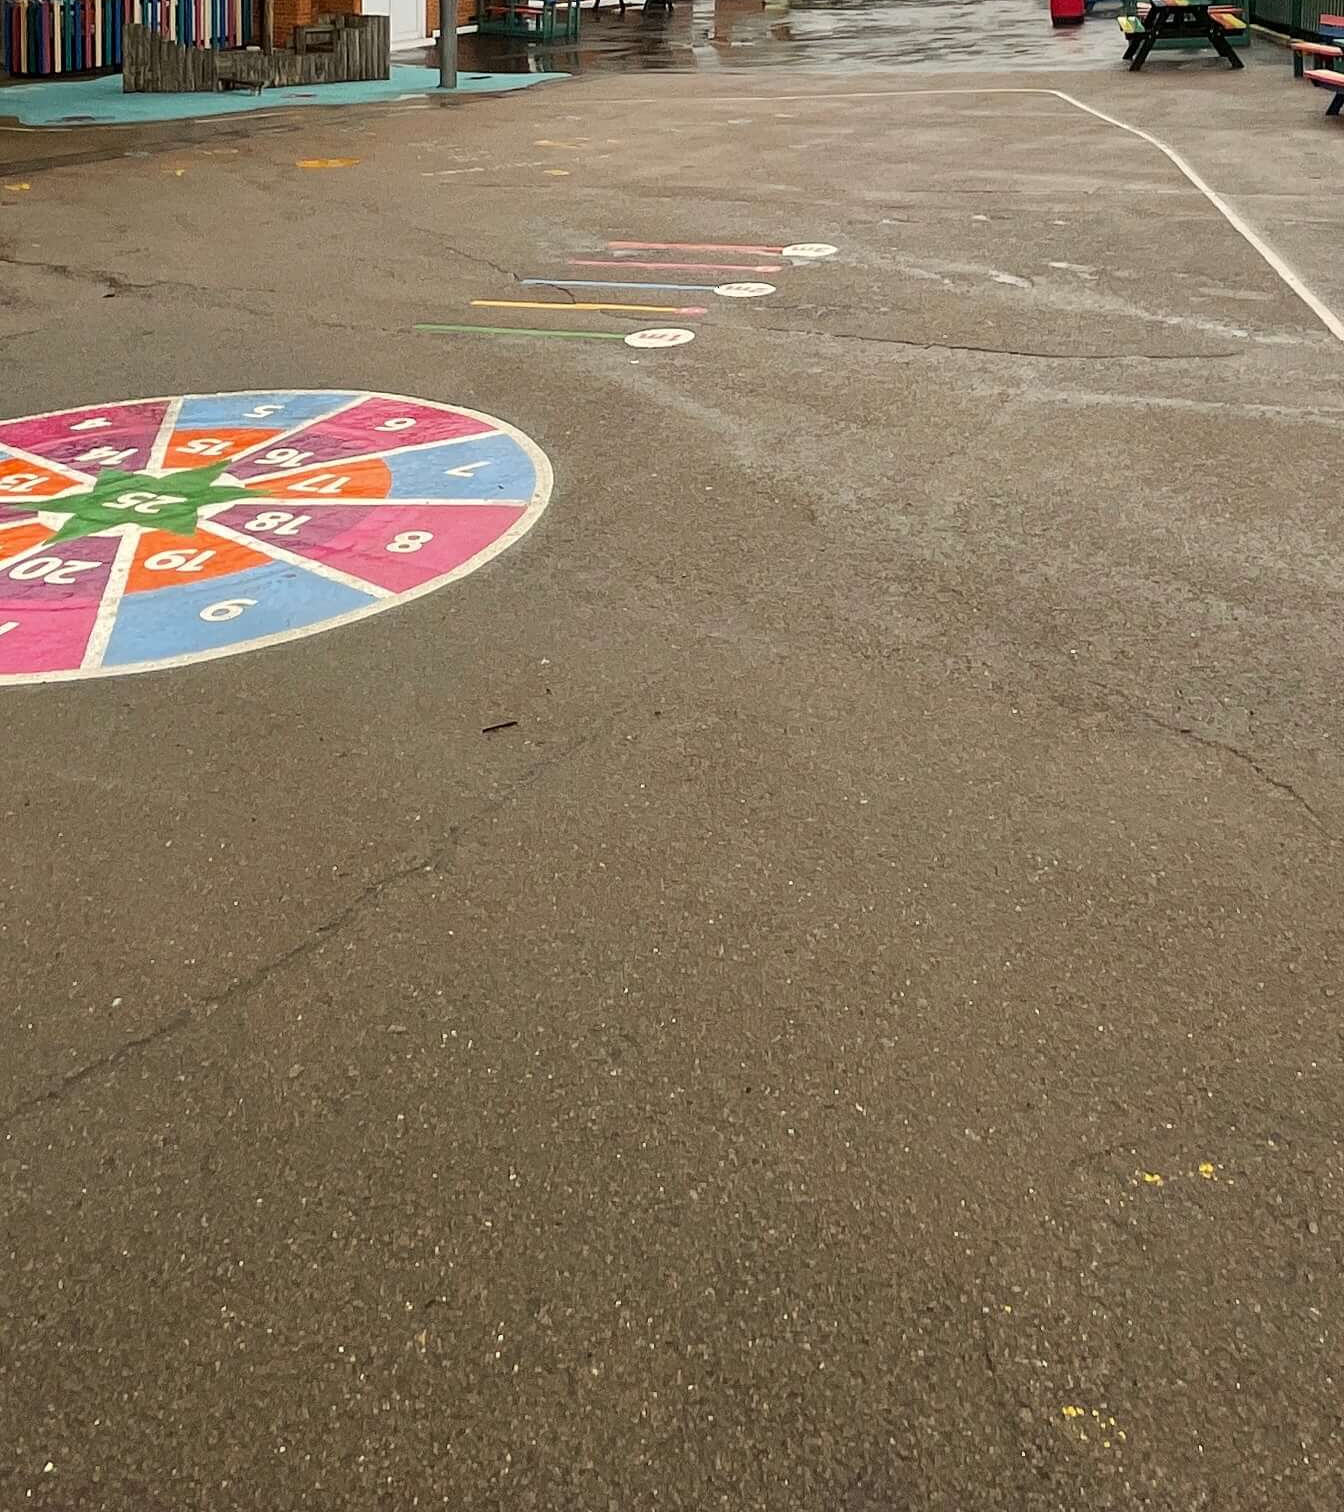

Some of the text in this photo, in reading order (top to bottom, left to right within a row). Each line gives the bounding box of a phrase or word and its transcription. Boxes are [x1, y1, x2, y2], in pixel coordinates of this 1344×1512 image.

[242, 404, 286, 419] 5
[70, 417, 113, 431] 4
[374, 417, 417, 432] 6
[73, 446, 138, 465] 14
[176, 438, 235, 456] 15
[253, 448, 316, 468] 16
[442, 460, 492, 477] 7
[287, 474, 350, 494] 17
[102, 492, 188, 514] 25
[244, 511, 313, 536] 18
[385, 530, 434, 553] 8
[8, 556, 103, 585] 20
[144, 549, 216, 572] 19
[199, 598, 259, 622] 9
